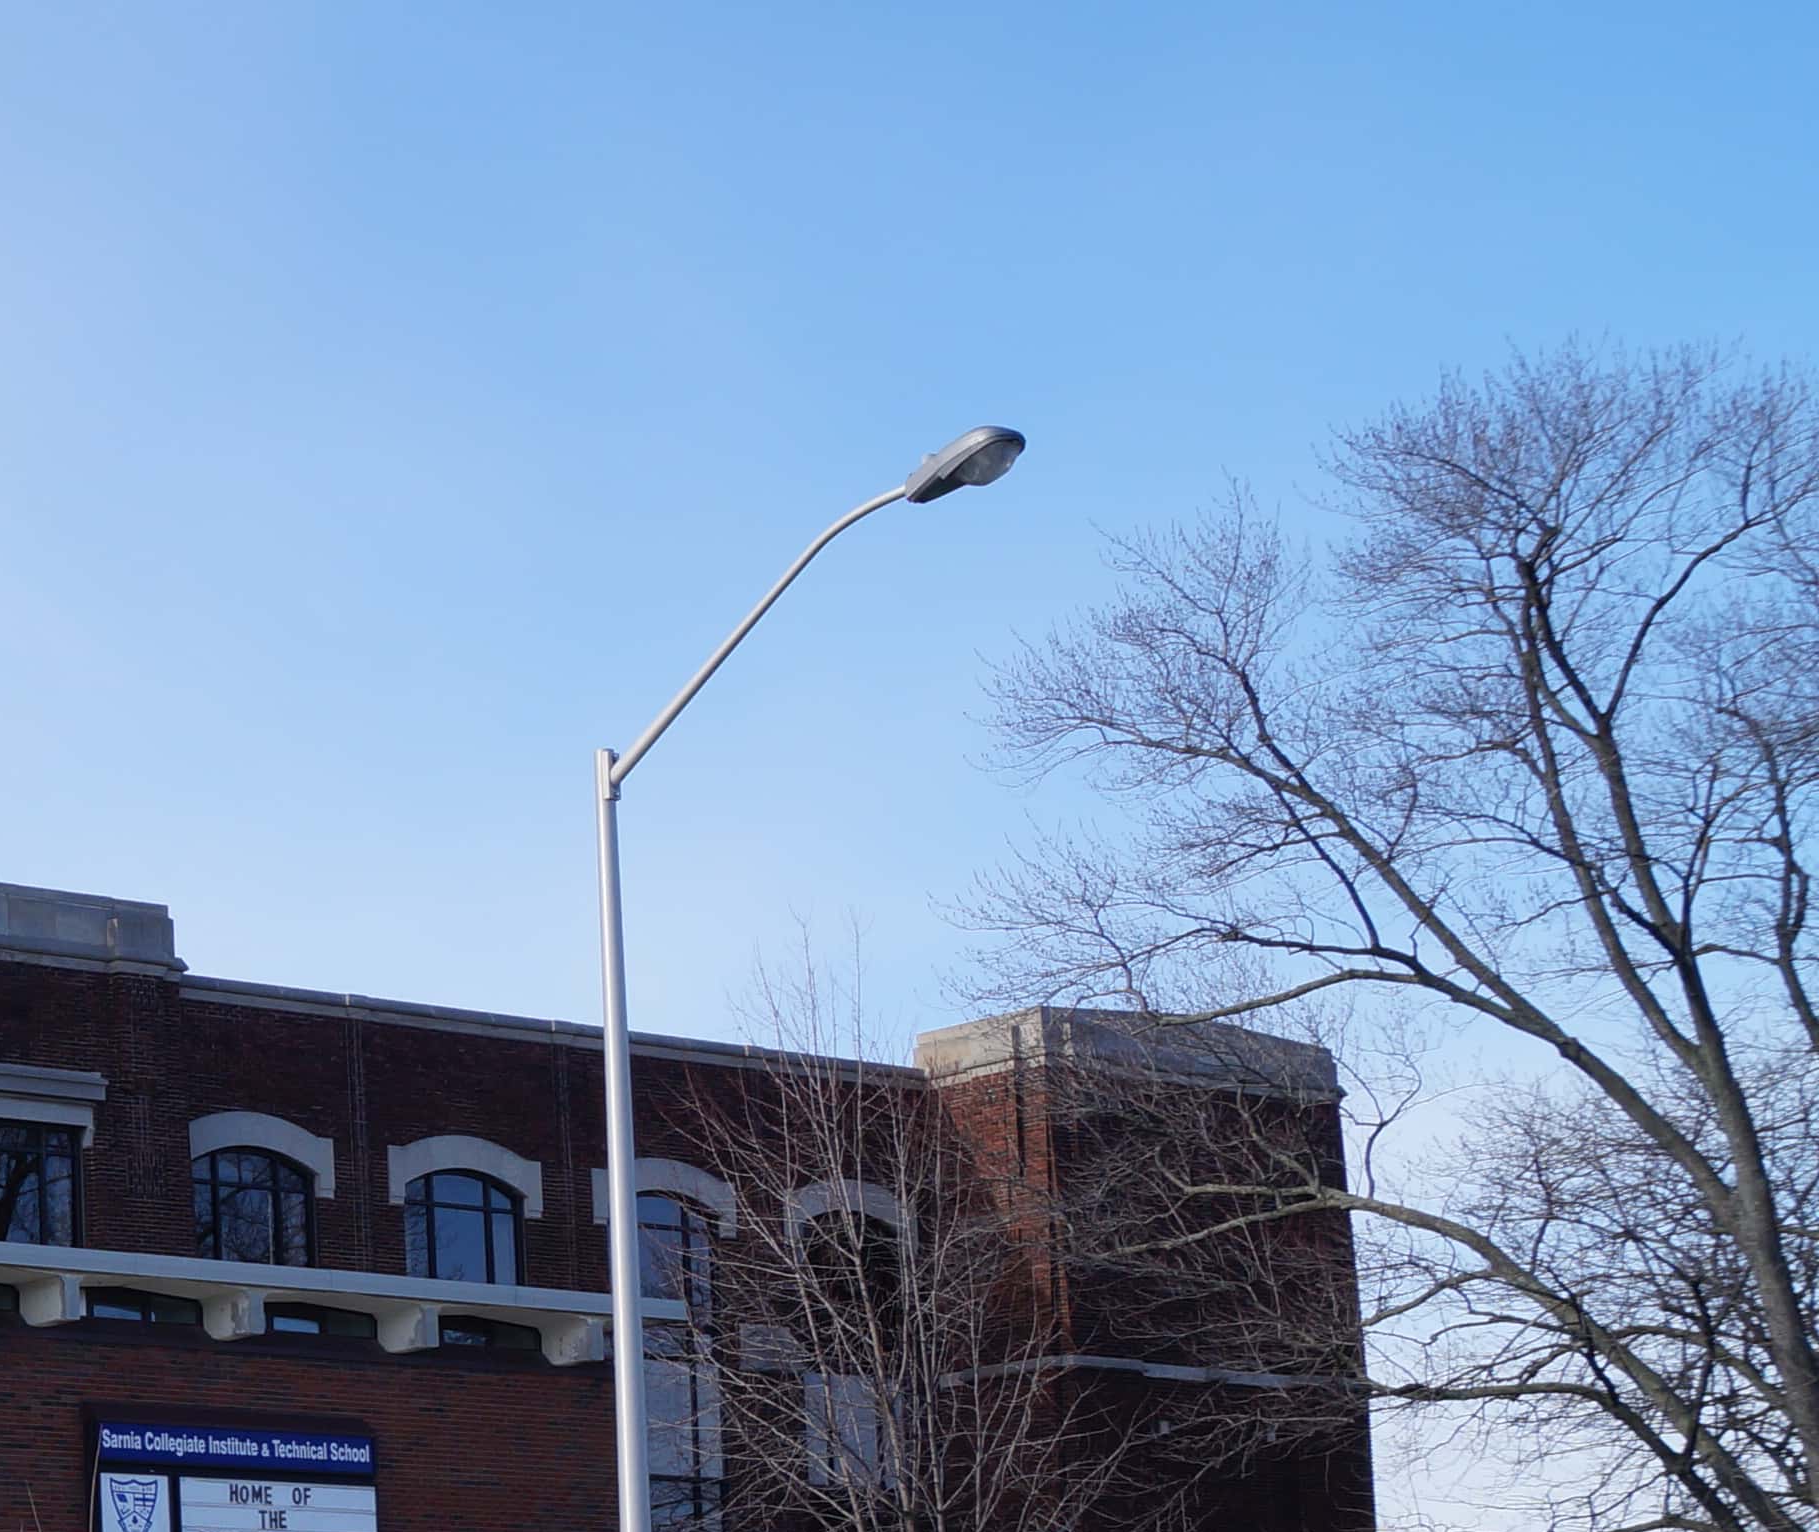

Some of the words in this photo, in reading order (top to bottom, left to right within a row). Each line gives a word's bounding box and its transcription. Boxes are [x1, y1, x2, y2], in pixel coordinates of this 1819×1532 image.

[102, 1428, 142, 1450] Sarnia
[145, 1431, 205, 1457] Collegiate
[209, 1435, 259, 1456] Institute
[261, 1442, 270, 1457] &
[272, 1439, 328, 1460] Technical
[330, 1442, 370, 1463] School
[229, 1483, 273, 1506] HOME
[292, 1487, 312, 1506] OF
[258, 1510, 287, 1530] THE
